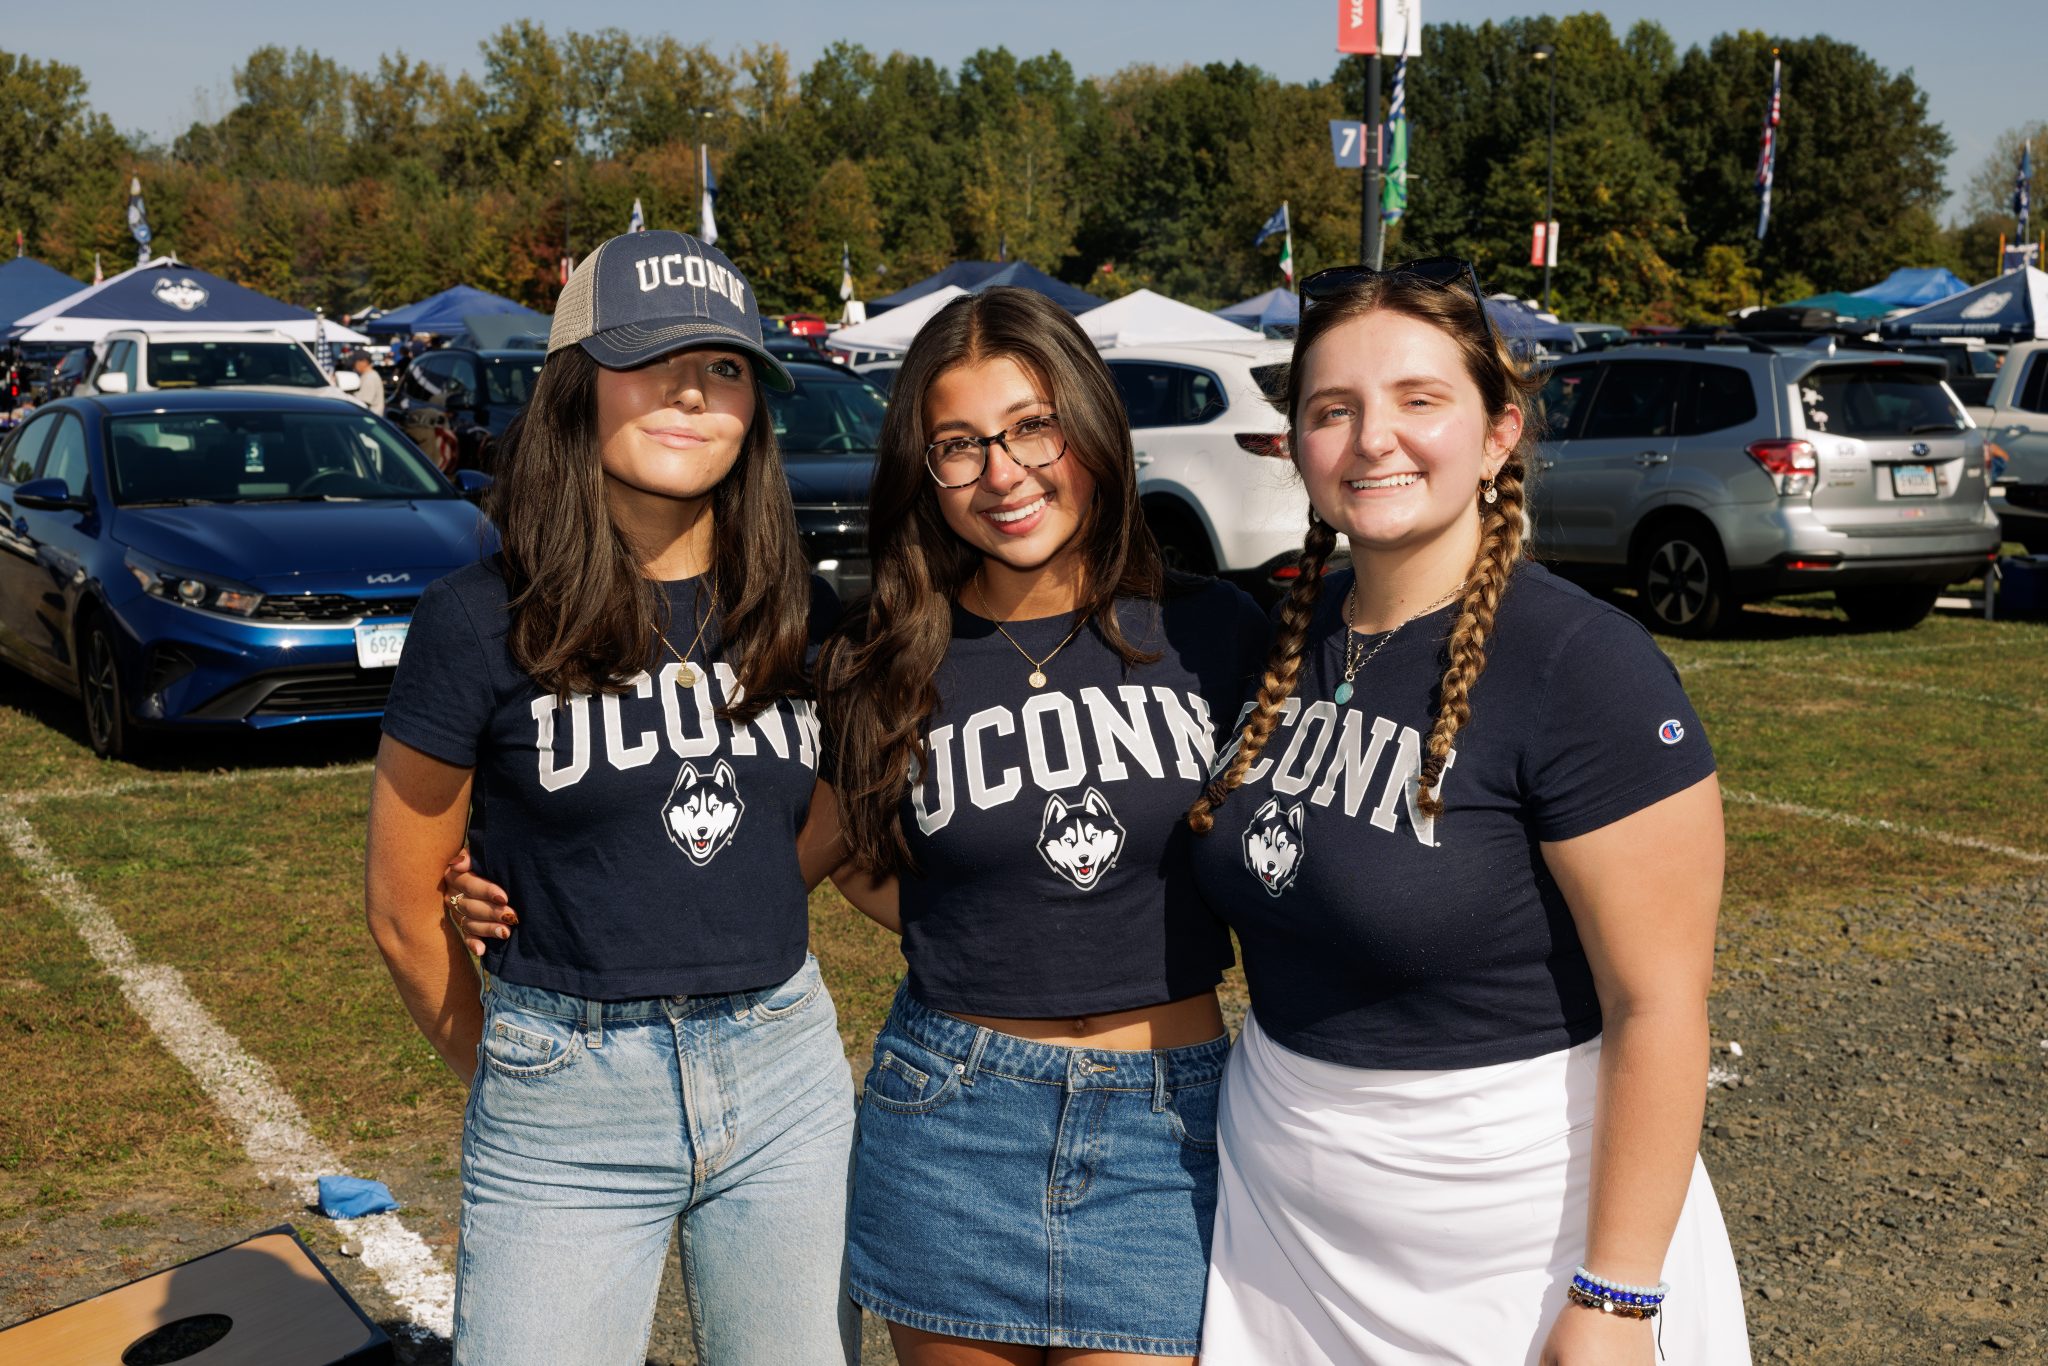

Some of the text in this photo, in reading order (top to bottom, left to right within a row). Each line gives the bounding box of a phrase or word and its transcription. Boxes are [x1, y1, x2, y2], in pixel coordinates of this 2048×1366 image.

[1341, 127, 1358, 157] 7
[635, 253, 746, 314] UCONN
[908, 685, 1218, 836] UCONN
